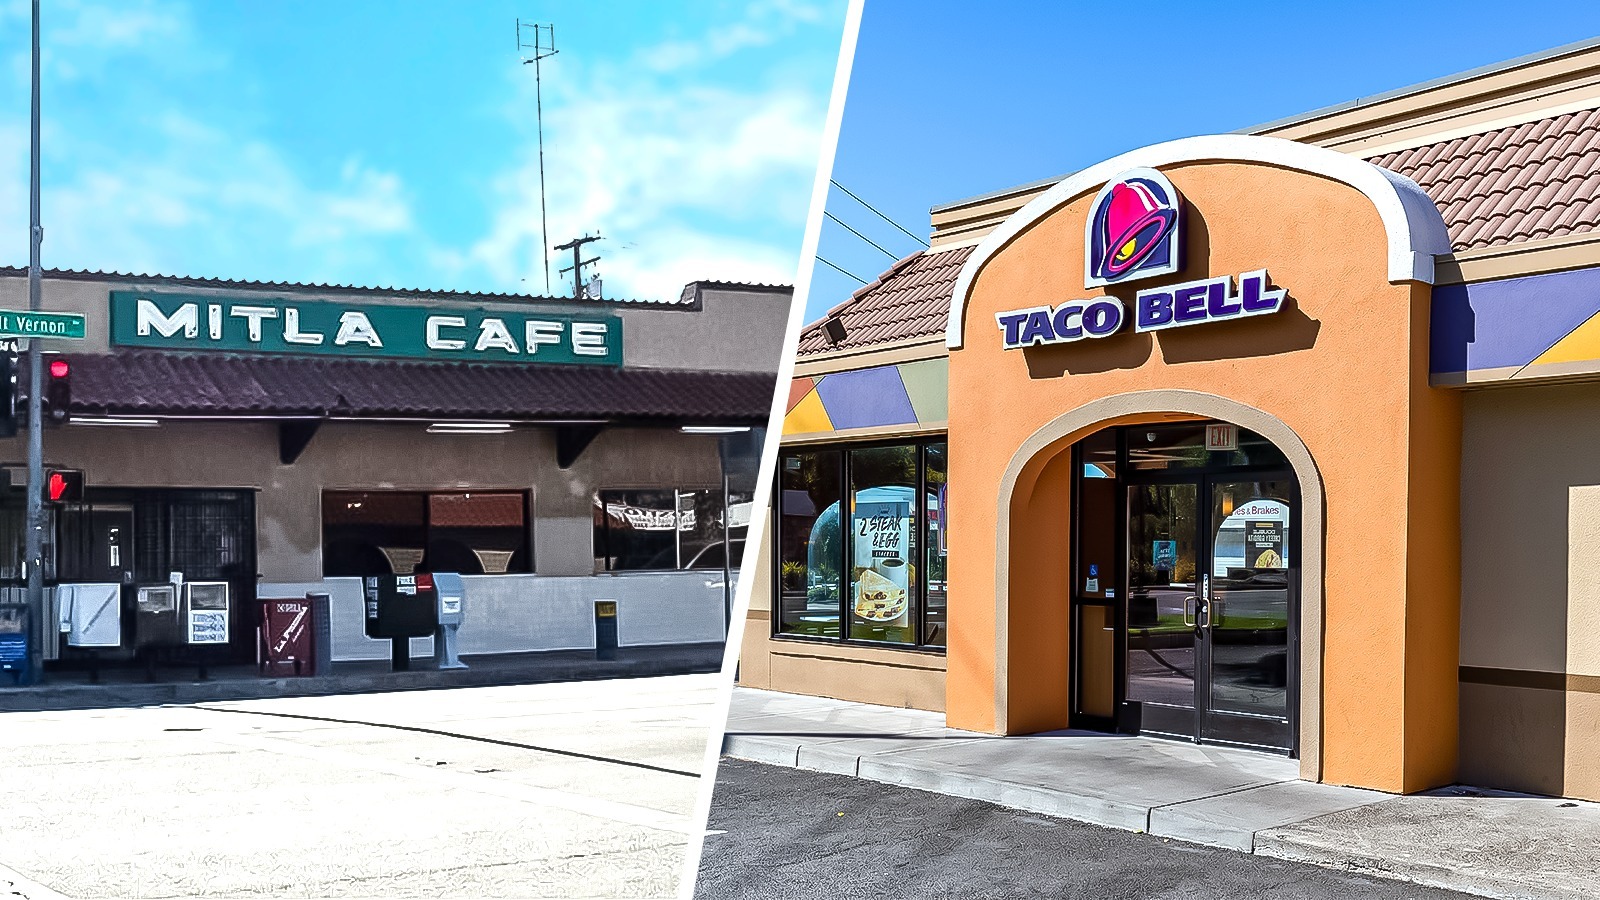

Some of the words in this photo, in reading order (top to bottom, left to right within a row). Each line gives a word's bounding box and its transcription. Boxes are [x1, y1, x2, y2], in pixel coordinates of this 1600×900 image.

[997, 301, 1121, 345] TACO
[1137, 276, 1279, 329] BELL
[0, 315, 8, 330] t
[16, 315, 66, 334] Vernon
[137, 299, 383, 348] MITLA
[426, 315, 608, 356] CAFE
[1210, 424, 1231, 447] EXIT
[1251, 505, 1279, 515] Brakes
[860, 517, 868, 537] 2
[869, 513, 902, 533] STEAK
